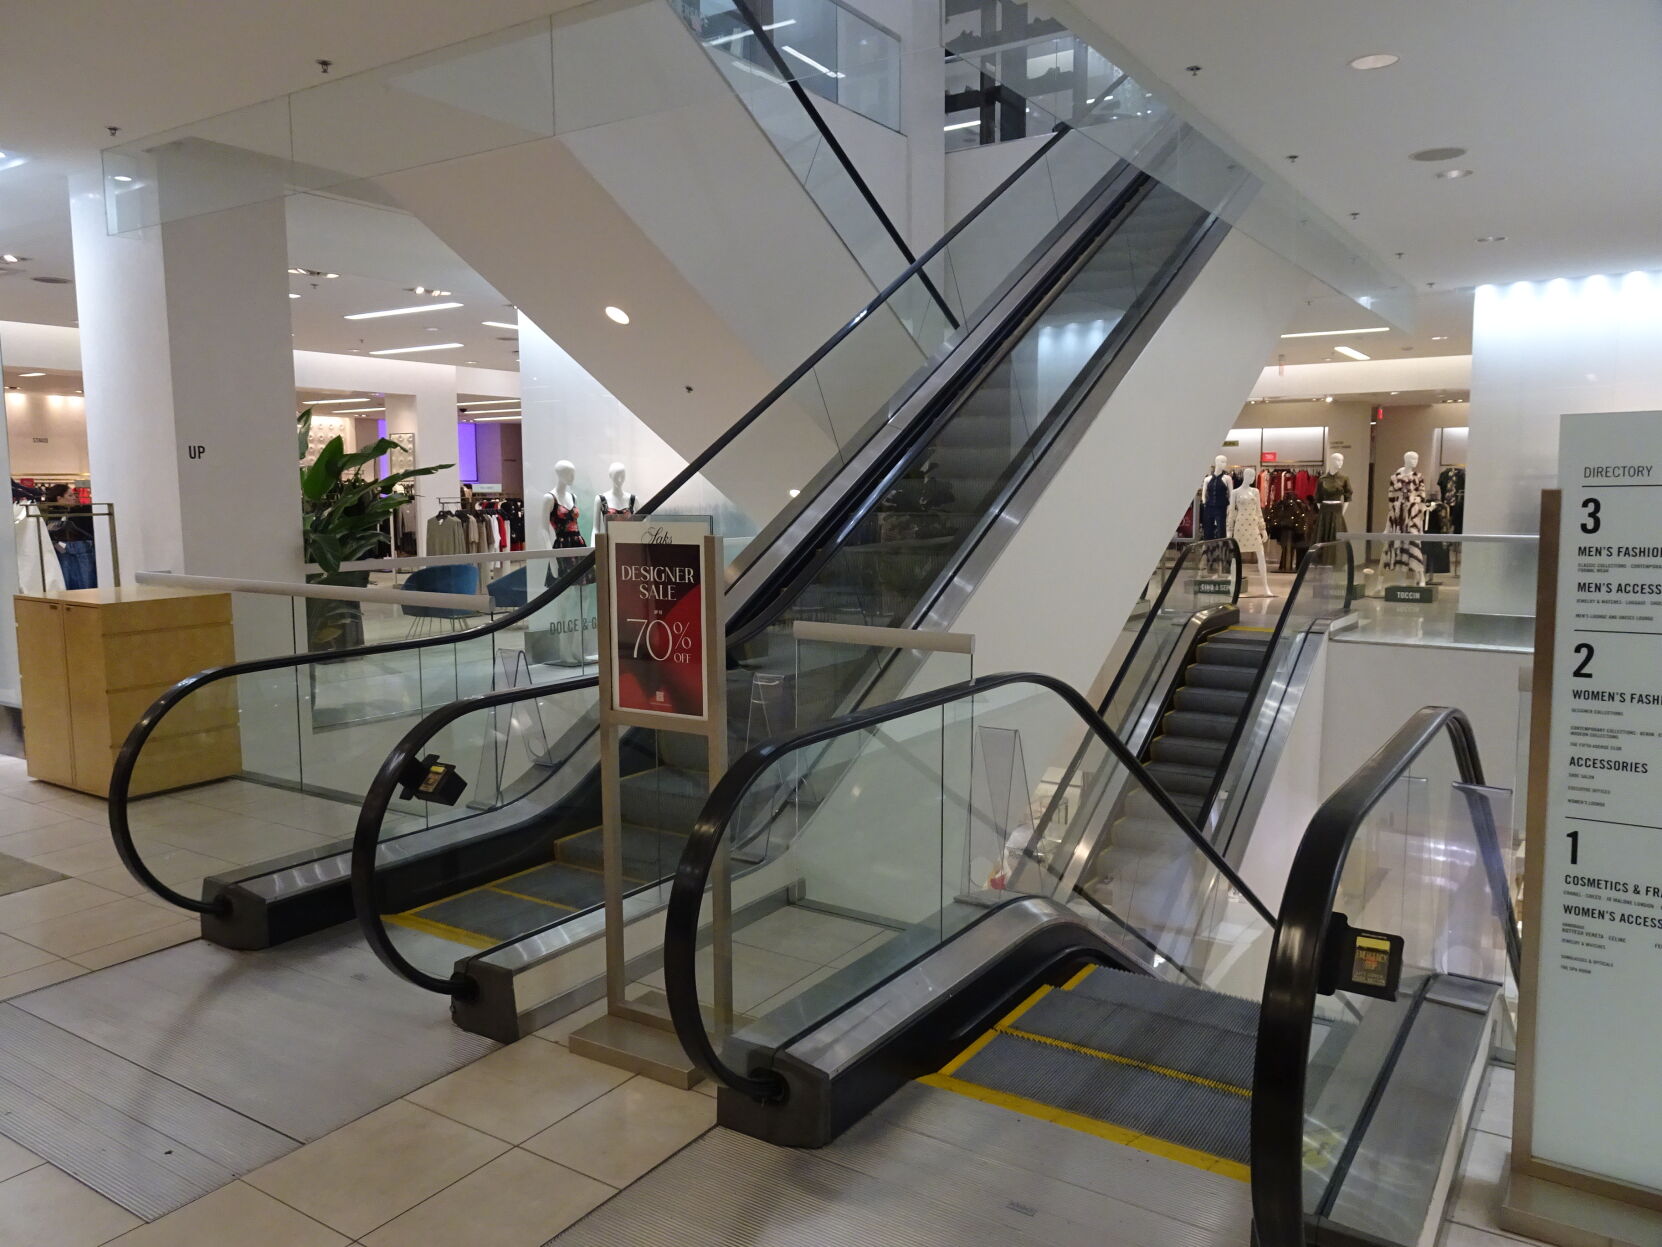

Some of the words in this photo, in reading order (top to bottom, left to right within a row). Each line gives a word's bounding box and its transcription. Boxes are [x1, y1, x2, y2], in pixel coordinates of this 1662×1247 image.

[188, 446, 206, 459] UP
[1584, 465, 1653, 478] DIRECTORY
[1580, 498, 1601, 534] 3
[1578, 546, 1614, 557] MEN'S
[1618, 546, 1662, 558] FASHIO
[622, 566, 694, 584] DESIGNER
[640, 584, 676, 600] SALE
[1577, 582, 1612, 594] MEN'S
[1616, 583, 1662, 595] ACCESS
[550, 619, 579, 635] DOLCE
[626, 619, 692, 660] 70%
[674, 653, 691, 664] OFF
[1572, 642, 1595, 678] 2
[1572, 689, 1626, 703] WOMEN'S
[1569, 756, 1648, 774] ACCESSORIES
[1566, 831, 1578, 864] 1
[1565, 874, 1629, 893] COSMETICS
[1633, 884, 1641, 895] &
[1563, 904, 1616, 922] WOMEN'S
[1620, 913, 1662, 929] ACCESS
